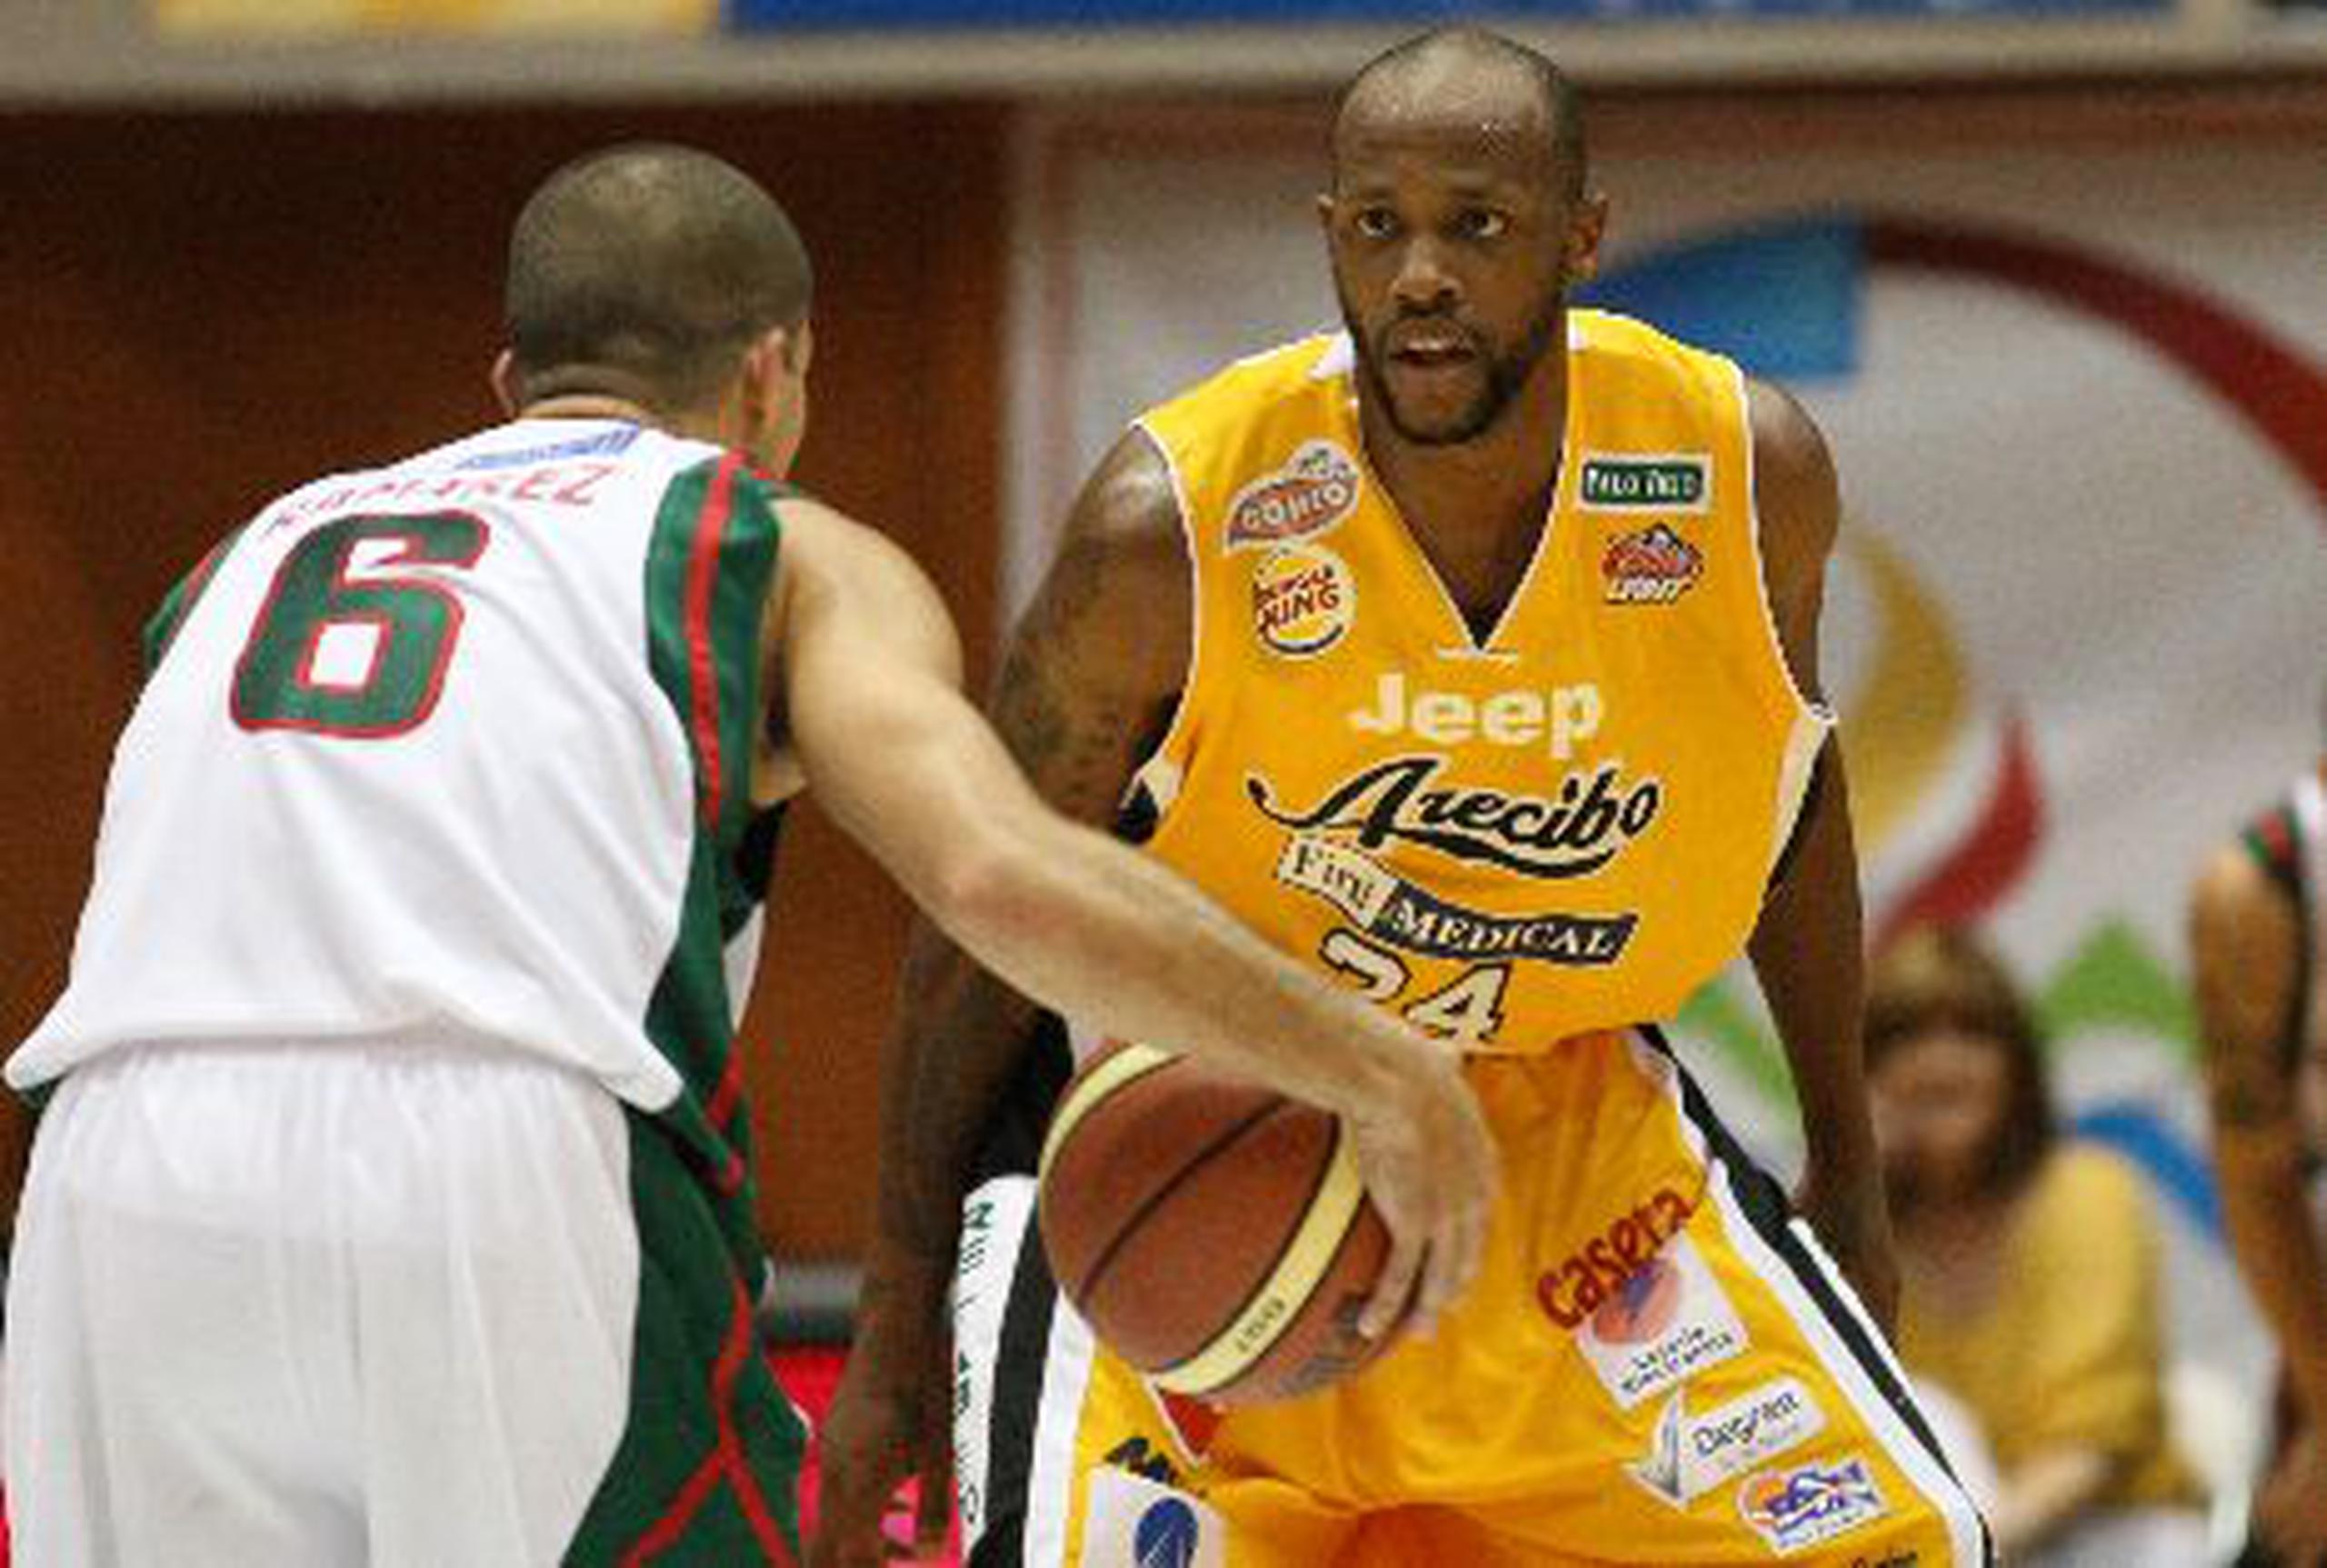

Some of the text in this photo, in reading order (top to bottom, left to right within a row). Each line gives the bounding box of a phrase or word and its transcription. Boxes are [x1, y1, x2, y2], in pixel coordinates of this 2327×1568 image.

[231, 507, 490, 740] 6
[1258, 584, 1340, 633] KING
[1349, 673, 1603, 760] Jeep
[1245, 753, 1662, 880] Arecibo
[1392, 898, 1616, 958] MEDICAL
